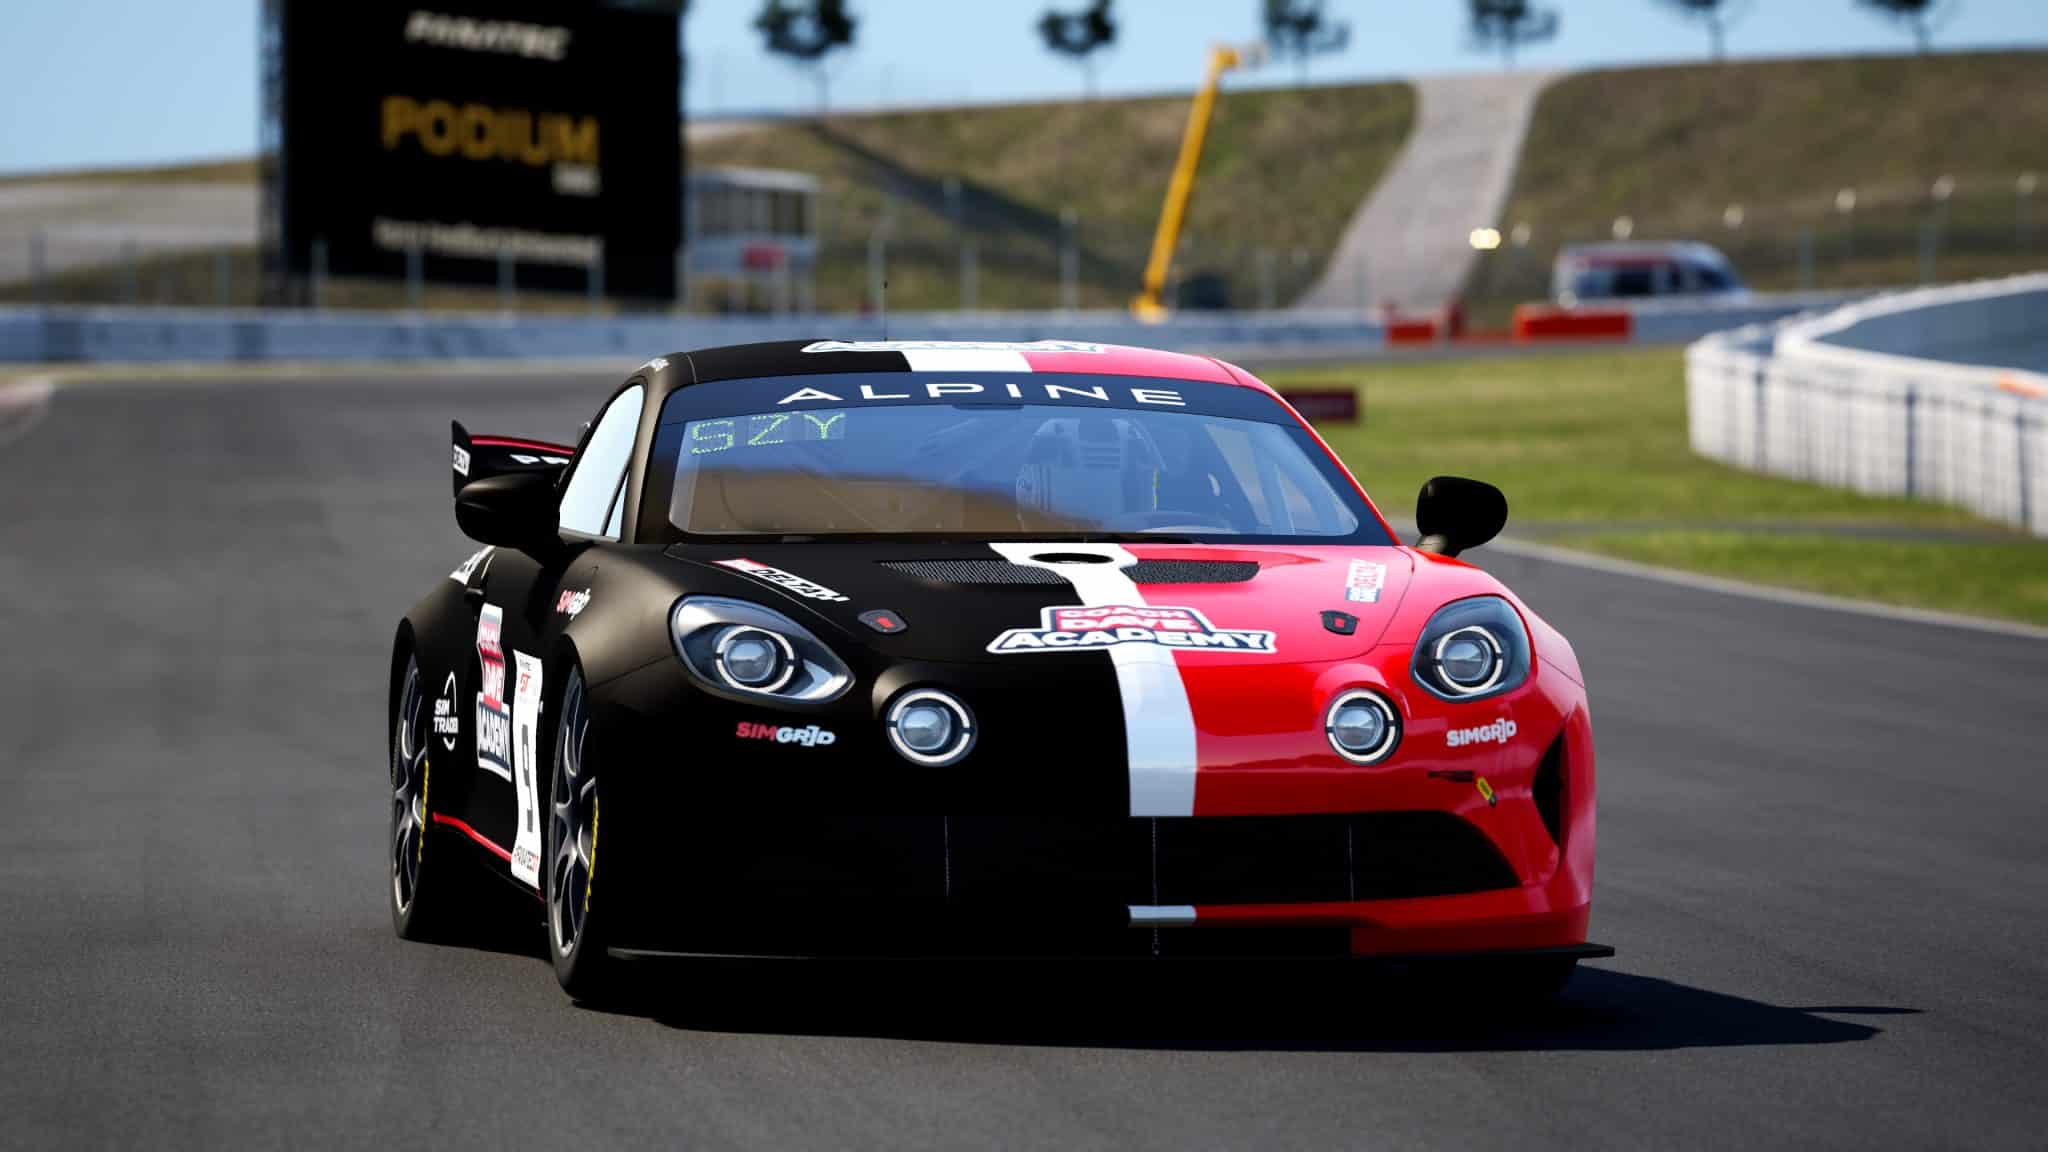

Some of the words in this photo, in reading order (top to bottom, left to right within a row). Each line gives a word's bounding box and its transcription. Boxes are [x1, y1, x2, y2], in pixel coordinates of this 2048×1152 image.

[381, 95, 600, 167] PODIUM
[777, 384, 1187, 405] ALPINE
[1058, 607, 1189, 619] COACH
[1059, 616, 1199, 631] DAVE
[1000, 627, 1269, 650] ACADEMY
[735, 721, 836, 748] SIMGRID
[1446, 717, 1517, 748] SIMGRID
